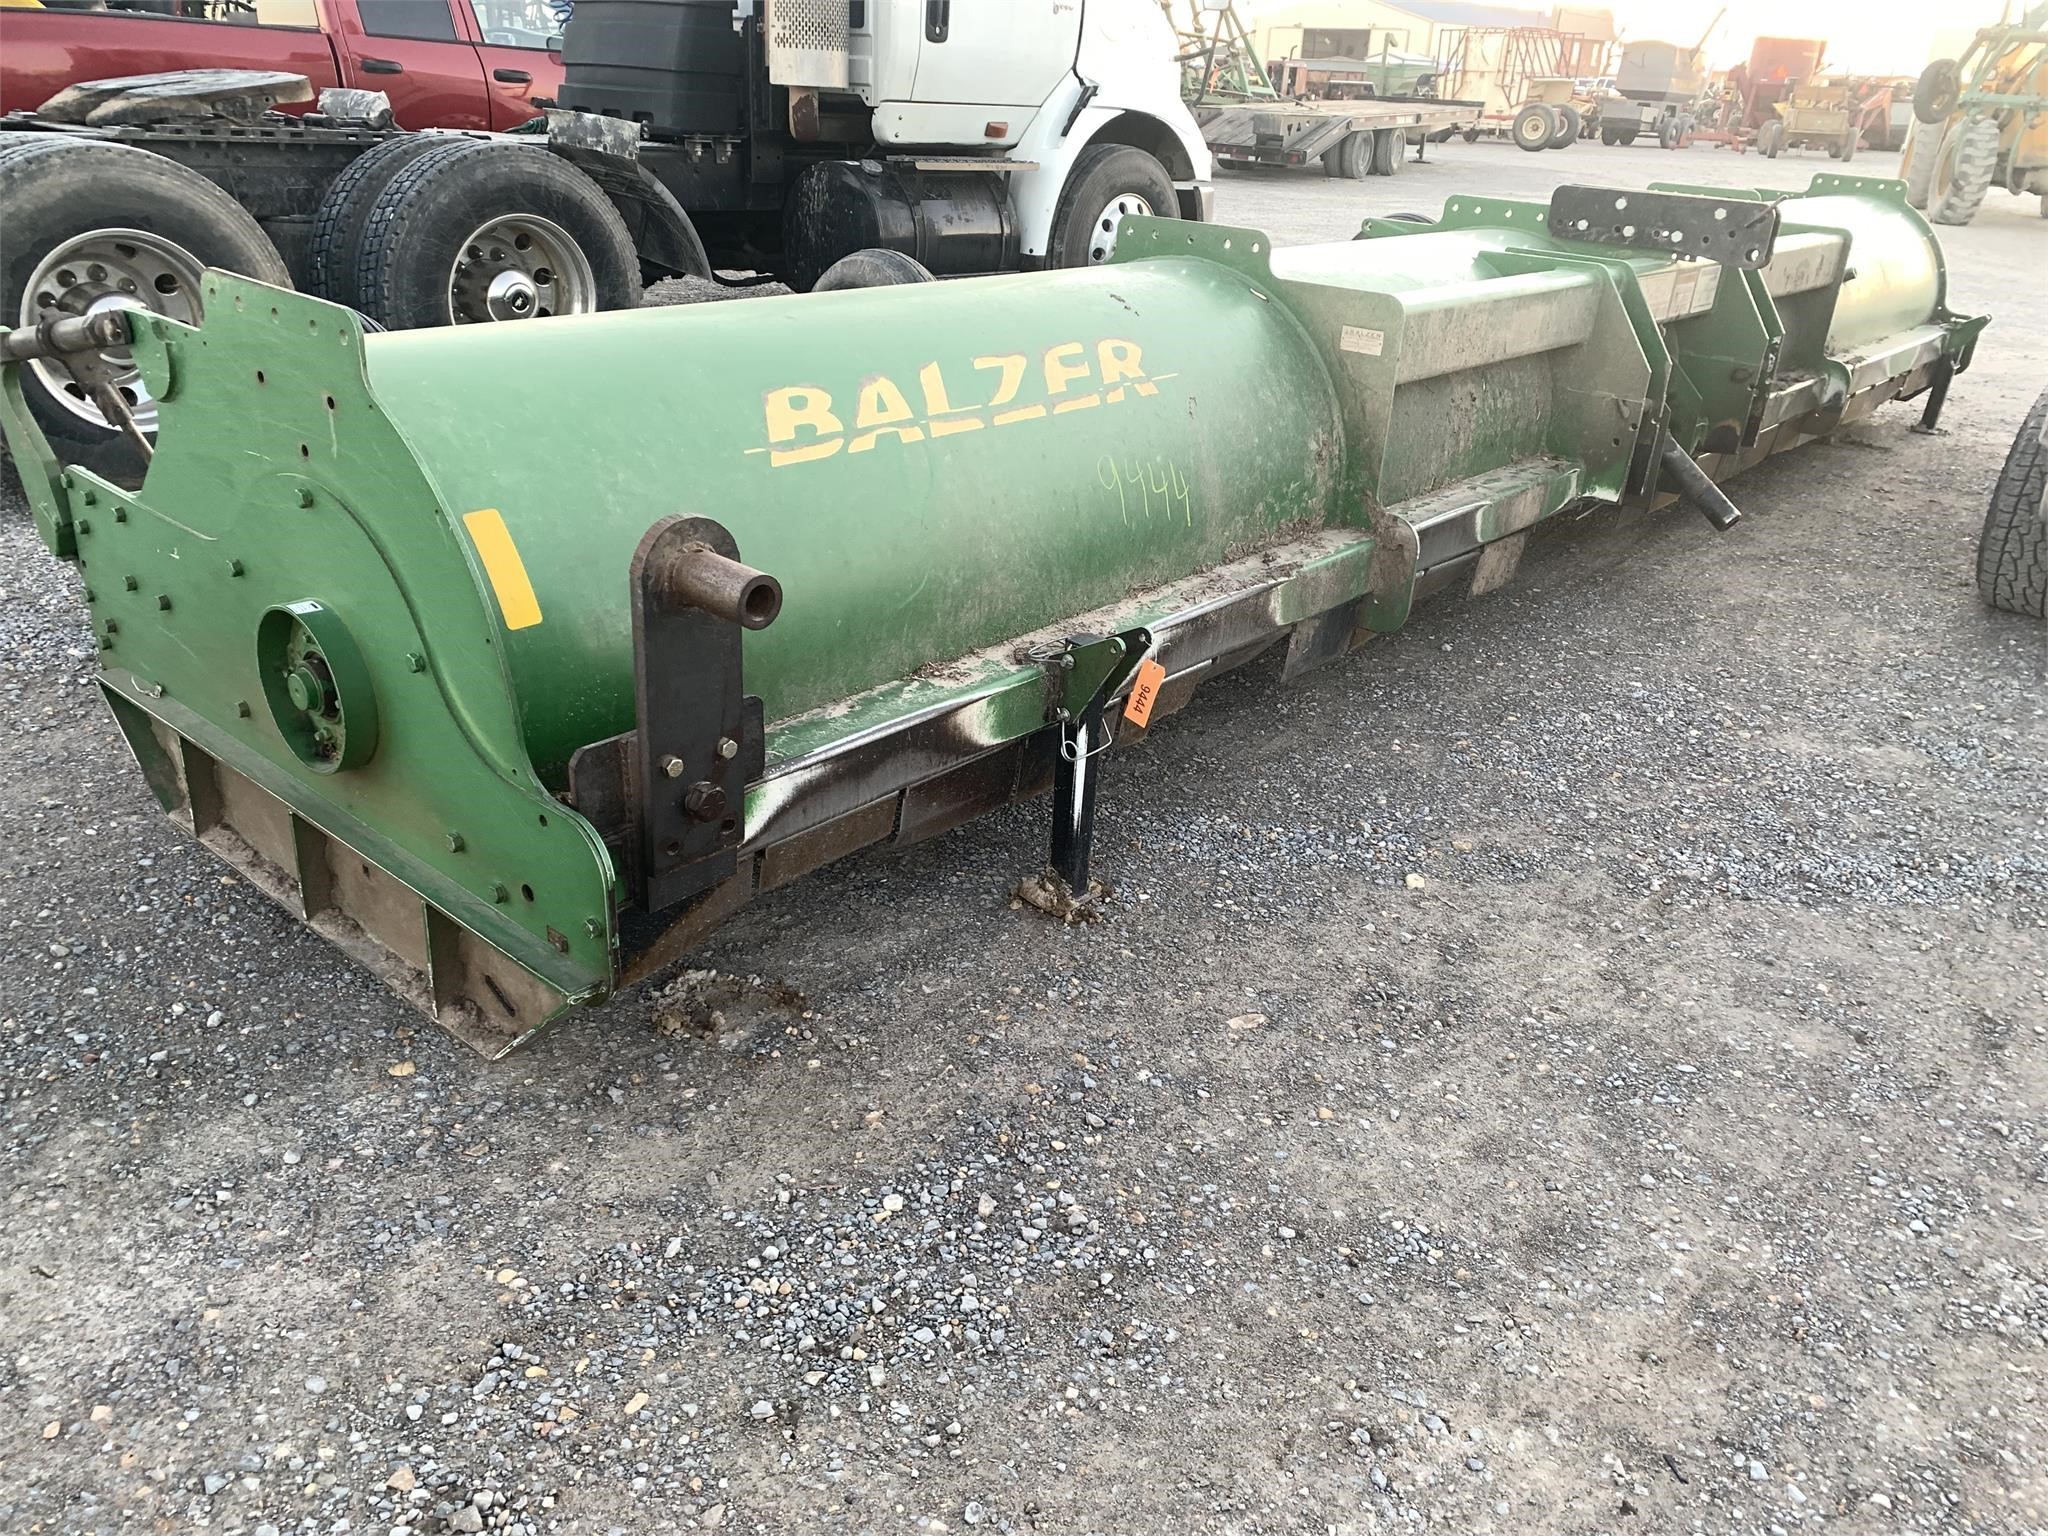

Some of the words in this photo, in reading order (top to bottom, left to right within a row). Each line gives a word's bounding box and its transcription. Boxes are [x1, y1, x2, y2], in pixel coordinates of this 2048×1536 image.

[764, 338, 1161, 468] BALZER
[1097, 454, 1191, 527] 9444
[1133, 684, 1151, 714] 9444
